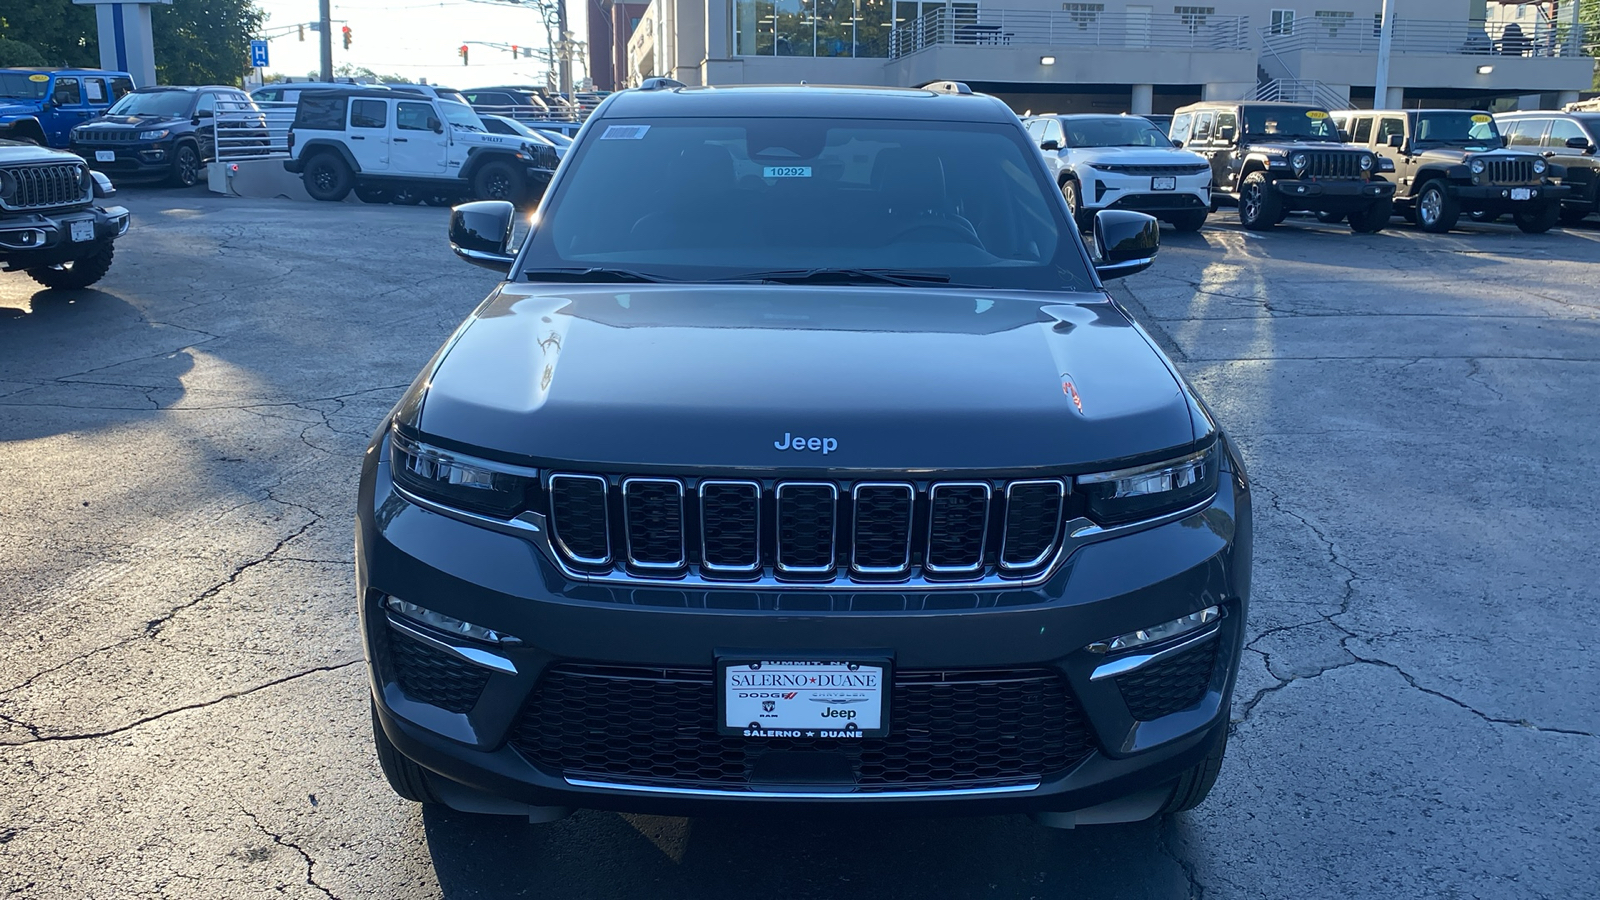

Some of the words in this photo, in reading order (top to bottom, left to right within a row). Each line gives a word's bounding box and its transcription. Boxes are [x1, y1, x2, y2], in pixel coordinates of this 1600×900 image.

[255, 46, 266, 60] H
[771, 168, 805, 176] 10292
[774, 432, 838, 455] Jeep
[731, 674, 808, 687] SALERNO
[818, 674, 877, 687] DUANE
[821, 707, 857, 720] Jeep
